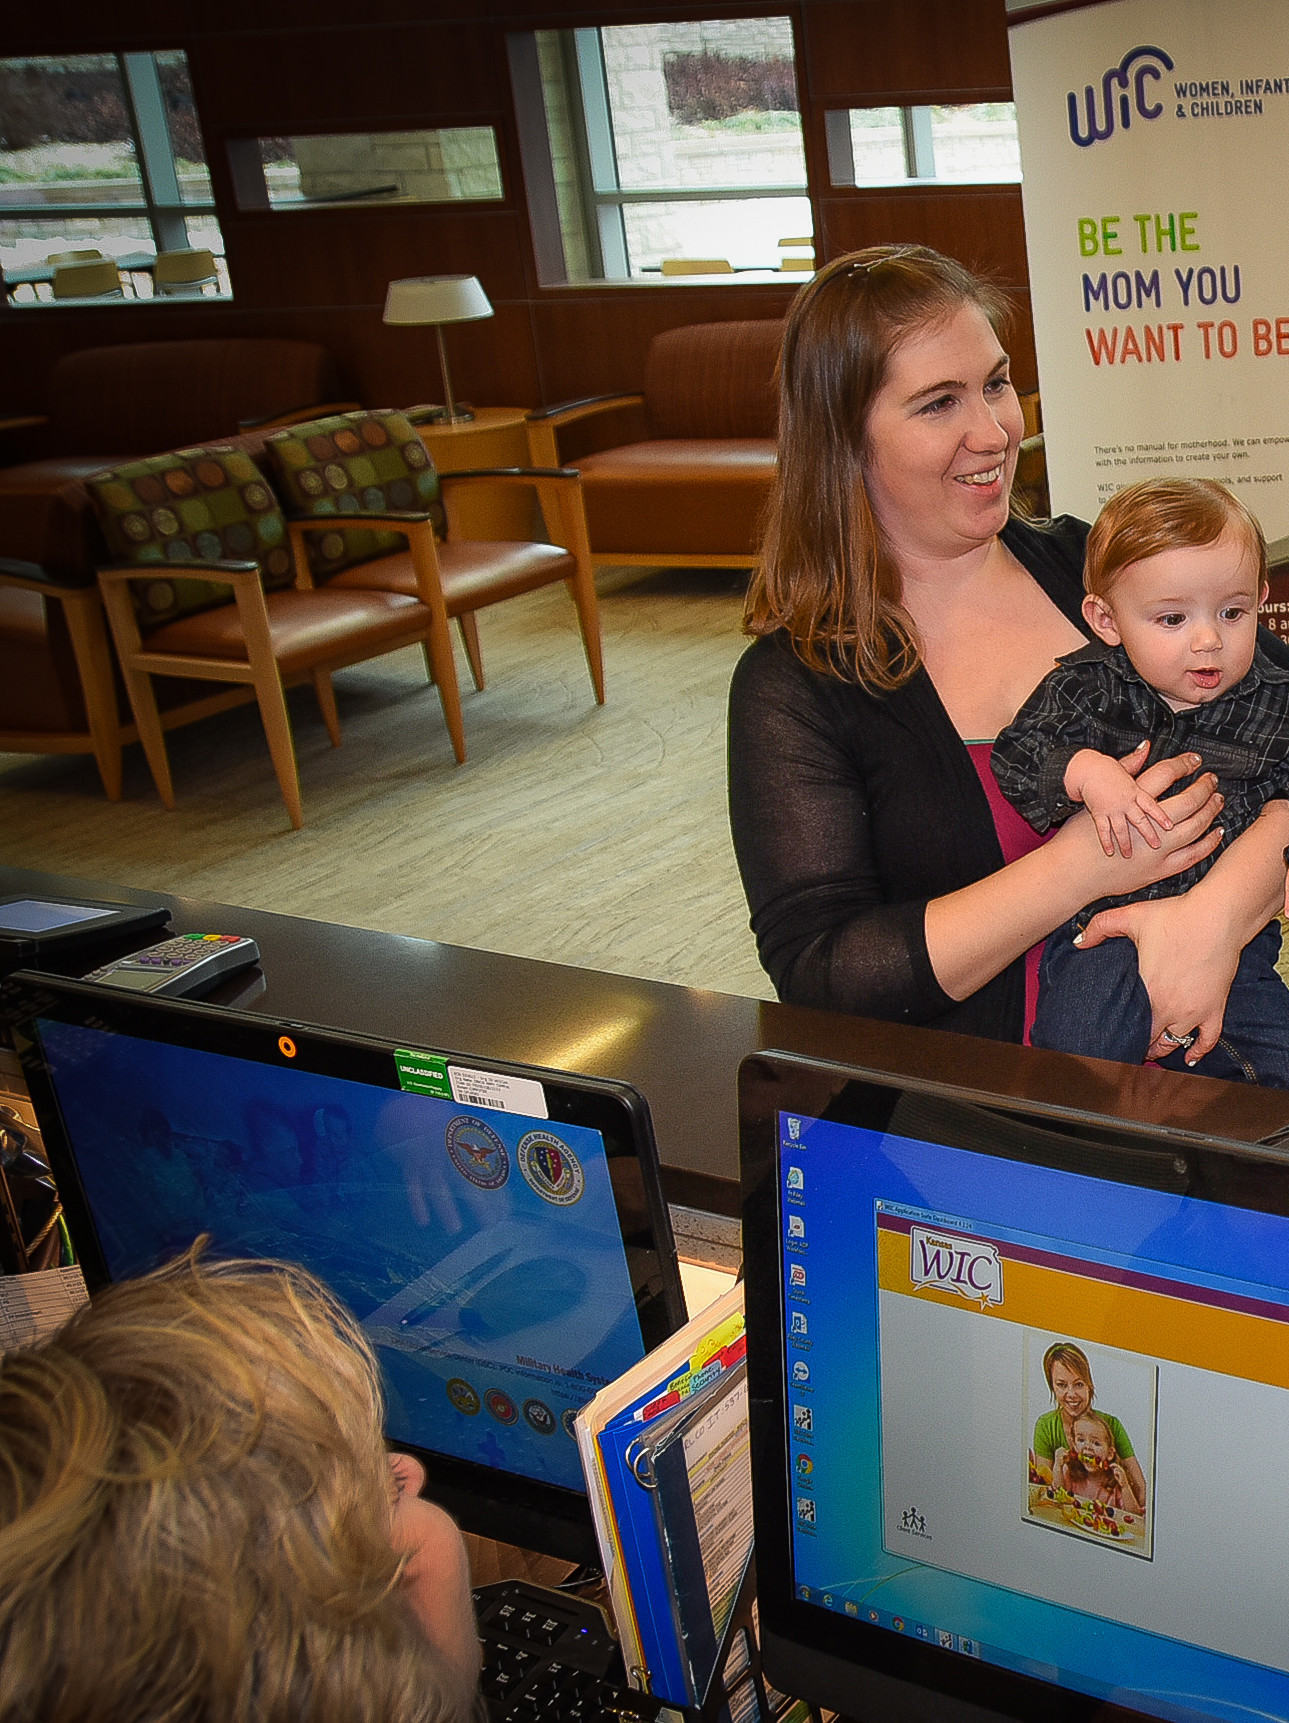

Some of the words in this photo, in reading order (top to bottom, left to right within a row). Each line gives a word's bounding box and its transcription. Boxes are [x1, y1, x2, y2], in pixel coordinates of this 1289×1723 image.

[1174, 80, 1235, 99] WOMEN,
[1176, 104, 1186, 118] &
[1190, 99, 1263, 117] CHILDREN
[1078, 216, 1122, 256] BE
[1133, 212, 1199, 254] THE
[1082, 269, 1161, 312] MOM
[1174, 265, 1242, 306] YOU
[1085, 322, 1184, 366] WANT
[1197, 319, 1238, 359] TO
[1137, 442, 1165, 451] manual
[1167, 441, 1179, 450] for
[1247, 437, 1261, 445] can
[1095, 457, 1112, 467] with
[1114, 456, 1127, 466] the
[1129, 454, 1173, 464] information
[1185, 452, 1210, 462] create
[1236, 475, 1251, 483] and
[1253, 473, 1283, 483] support
[1268, 618, 1277, 631] 8
[926, 1236, 952, 1250] Kansas
[919, 1240, 992, 1290] WIC
